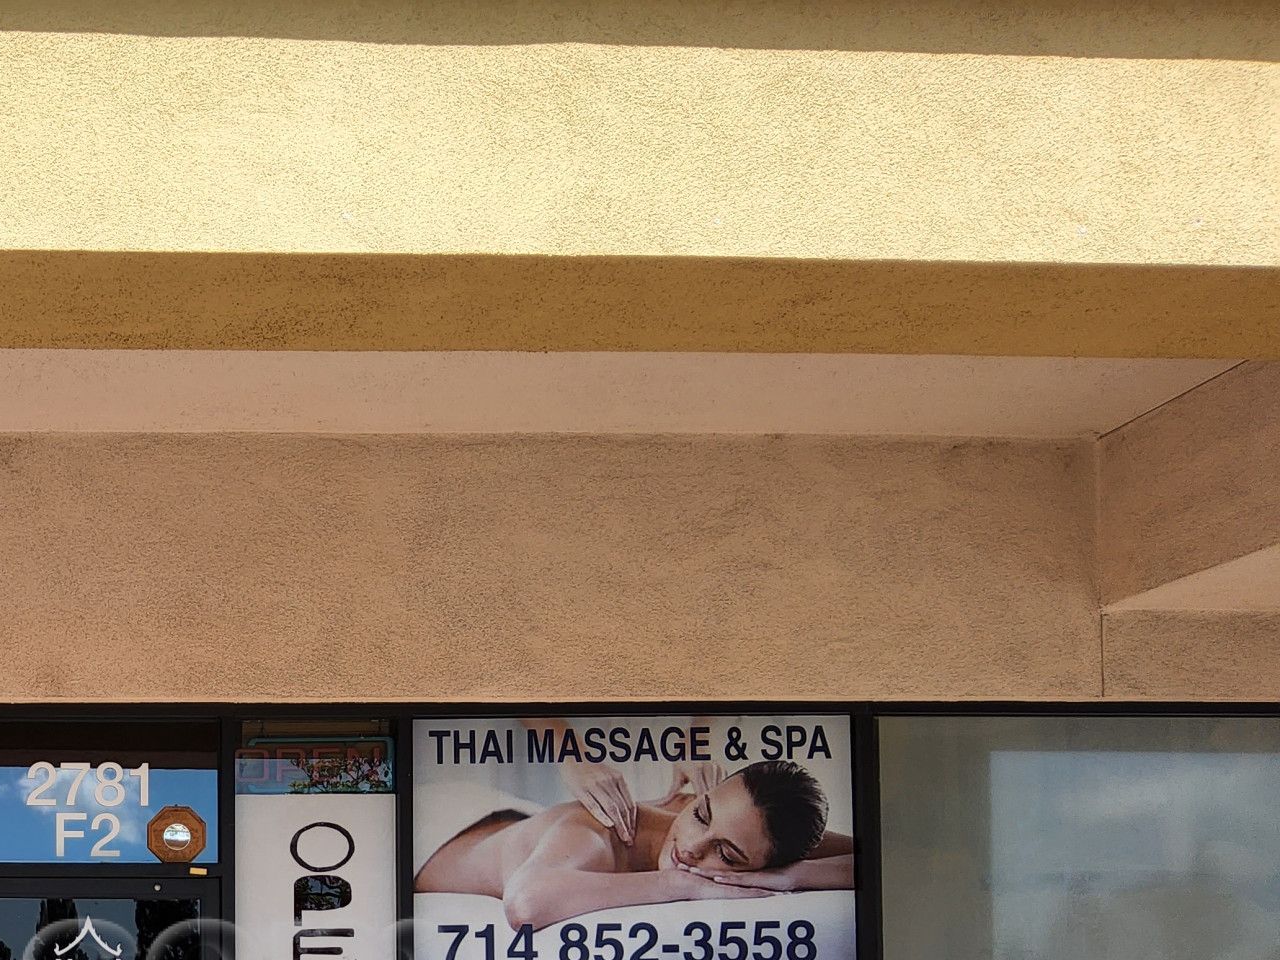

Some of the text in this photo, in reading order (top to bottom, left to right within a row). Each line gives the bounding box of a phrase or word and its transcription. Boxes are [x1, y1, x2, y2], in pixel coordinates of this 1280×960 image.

[429, 725, 832, 765] THAI MASSAGE & SPA
[26, 761, 150, 807] 2781
[55, 812, 120, 857] F2
